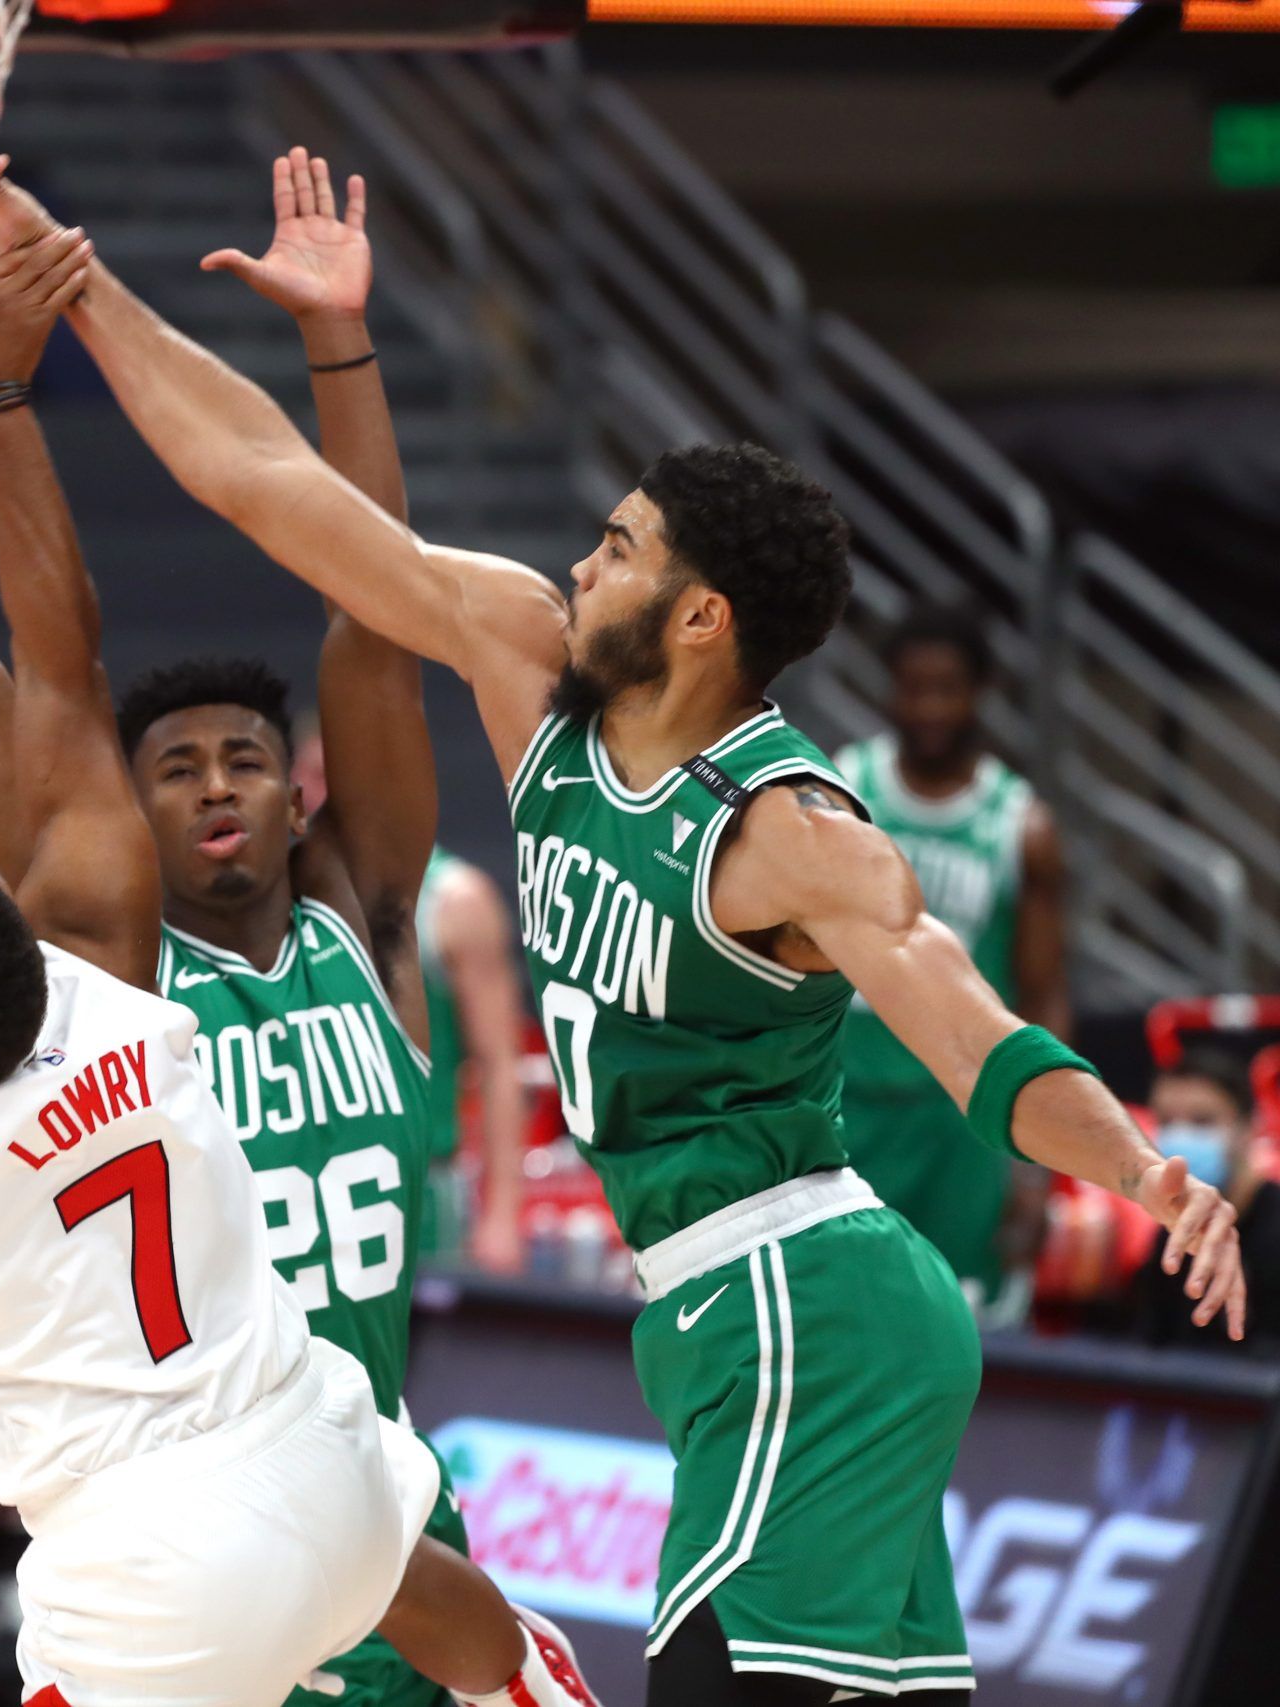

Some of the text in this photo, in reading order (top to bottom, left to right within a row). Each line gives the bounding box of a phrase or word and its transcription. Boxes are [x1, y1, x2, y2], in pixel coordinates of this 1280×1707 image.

[652, 848, 690, 876] vistaprint
[691, 759, 741, 802] TOMMY KC
[516, 830, 674, 1022] BOSTON
[7, 1039, 153, 1171] LOWRY
[541, 980, 598, 1145] 0
[53, 1139, 193, 1366] 7
[252, 1143, 408, 1313] 26
[942, 1489, 1202, 1690] GE
